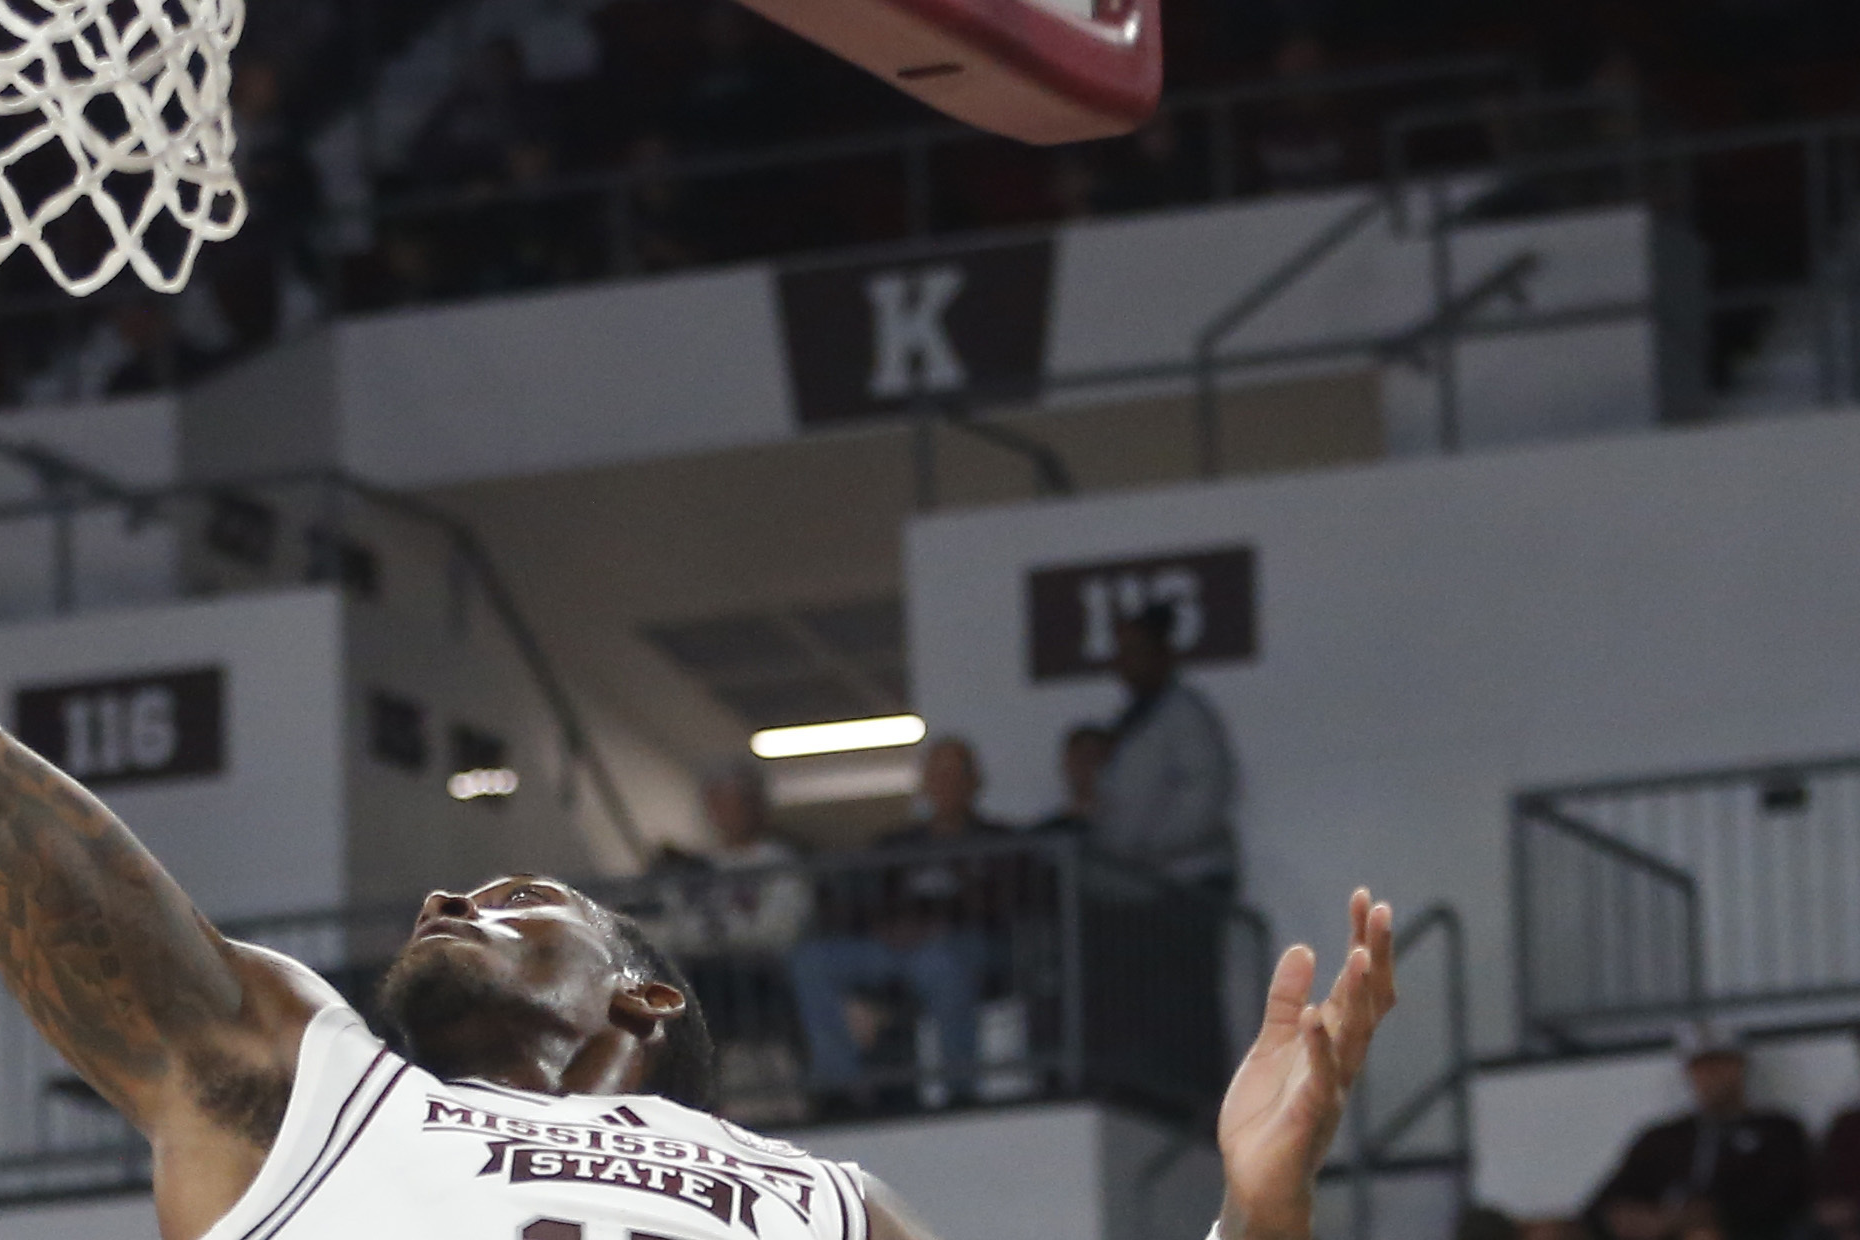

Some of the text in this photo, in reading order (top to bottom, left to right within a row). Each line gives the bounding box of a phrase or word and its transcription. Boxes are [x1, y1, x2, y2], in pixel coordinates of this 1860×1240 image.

[865, 268, 966, 394] K
[64, 686, 178, 776] 116
[528, 1151, 716, 1209] STATE
